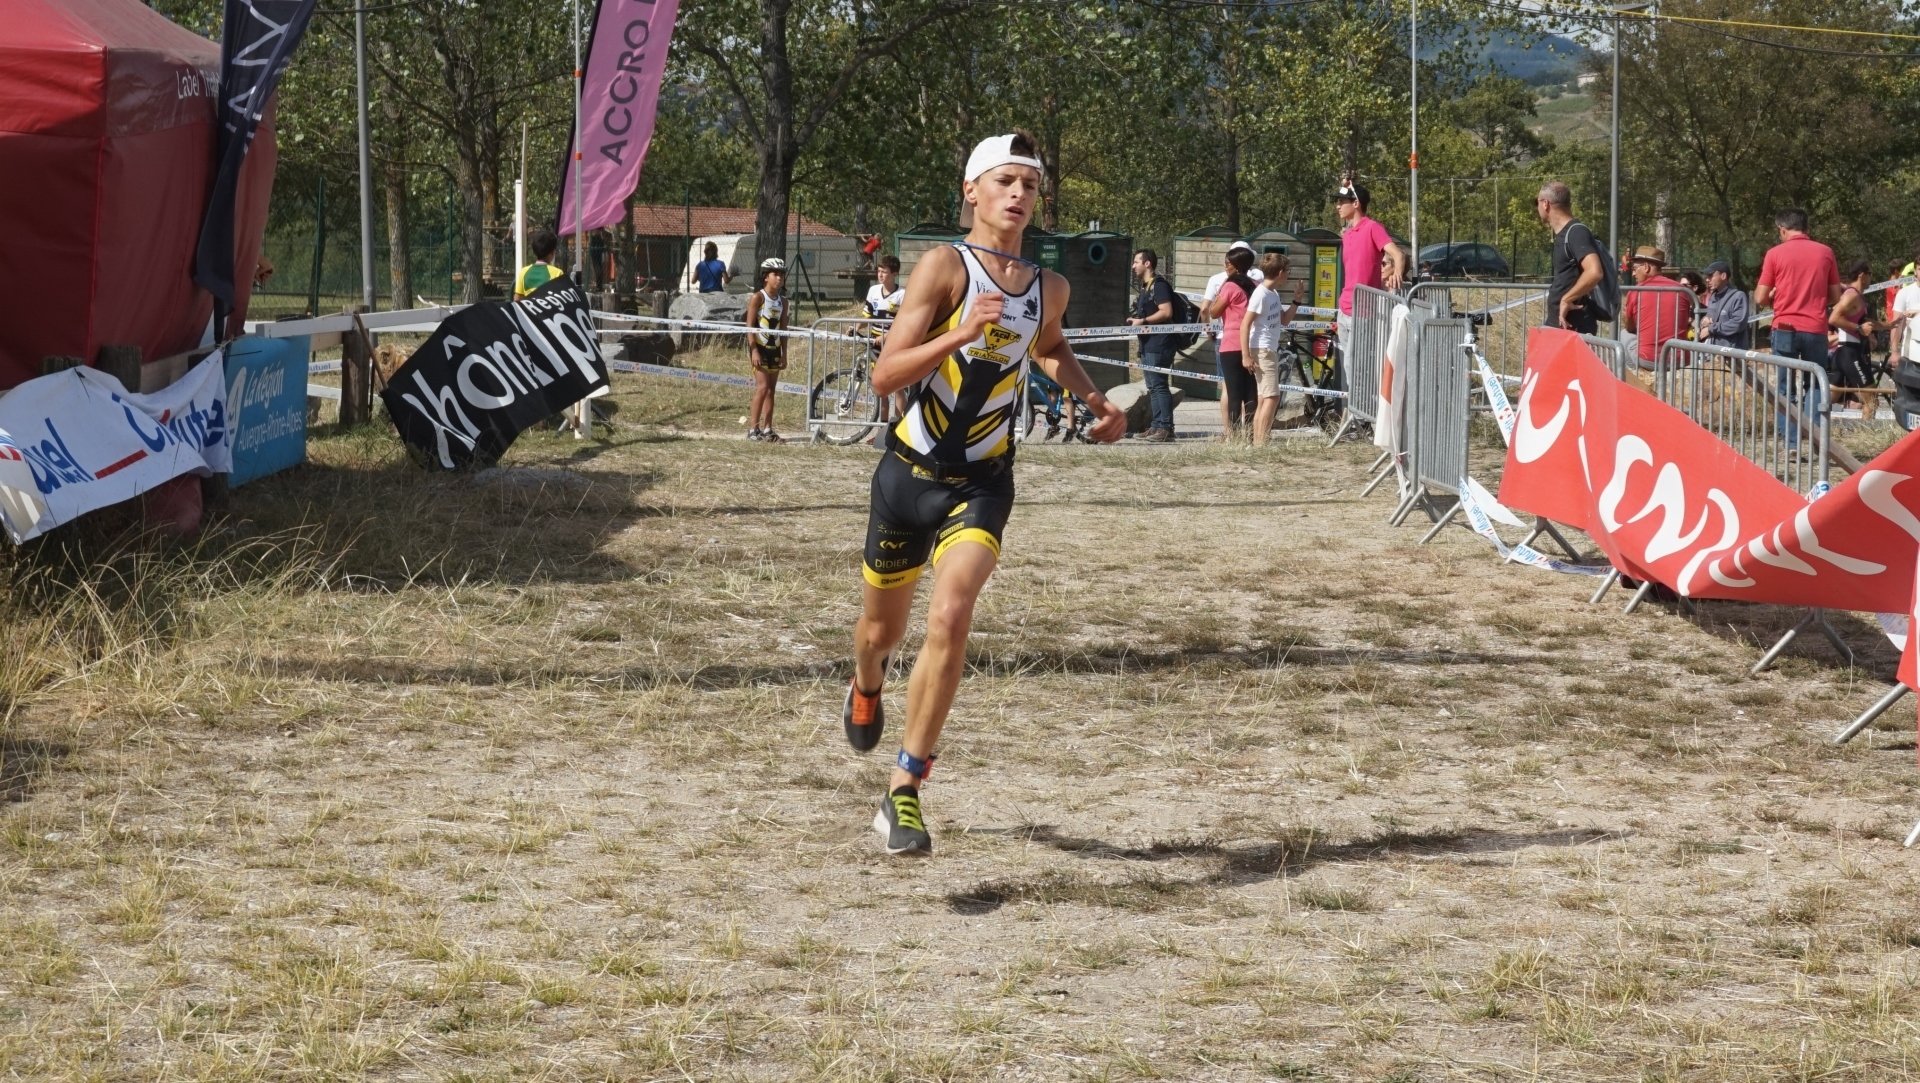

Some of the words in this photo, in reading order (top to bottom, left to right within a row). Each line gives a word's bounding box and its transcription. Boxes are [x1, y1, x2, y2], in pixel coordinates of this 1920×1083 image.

[176, 68, 199, 99] Label
[600, 19, 650, 167] ACCRO
[969, 350, 1009, 363] TRIATHLON
[243, 369, 257, 408] La
[256, 361, 285, 409] Région
[612, 361, 632, 370] Crédit
[640, 365, 664, 374] Mutuel
[669, 369, 689, 378] Crédit
[697, 373, 721, 382] Mutuel
[726, 377, 747, 386] Crédit
[783, 384, 803, 393] Crédit
[1487, 377, 1508, 410] Mutuel
[238, 405, 302, 453] Auvergne-Rhône-Alpes
[1470, 504, 1489, 531] Mutuel
[875, 558, 908, 568] DIDIER
[1516, 545, 1538, 562] Mutu
